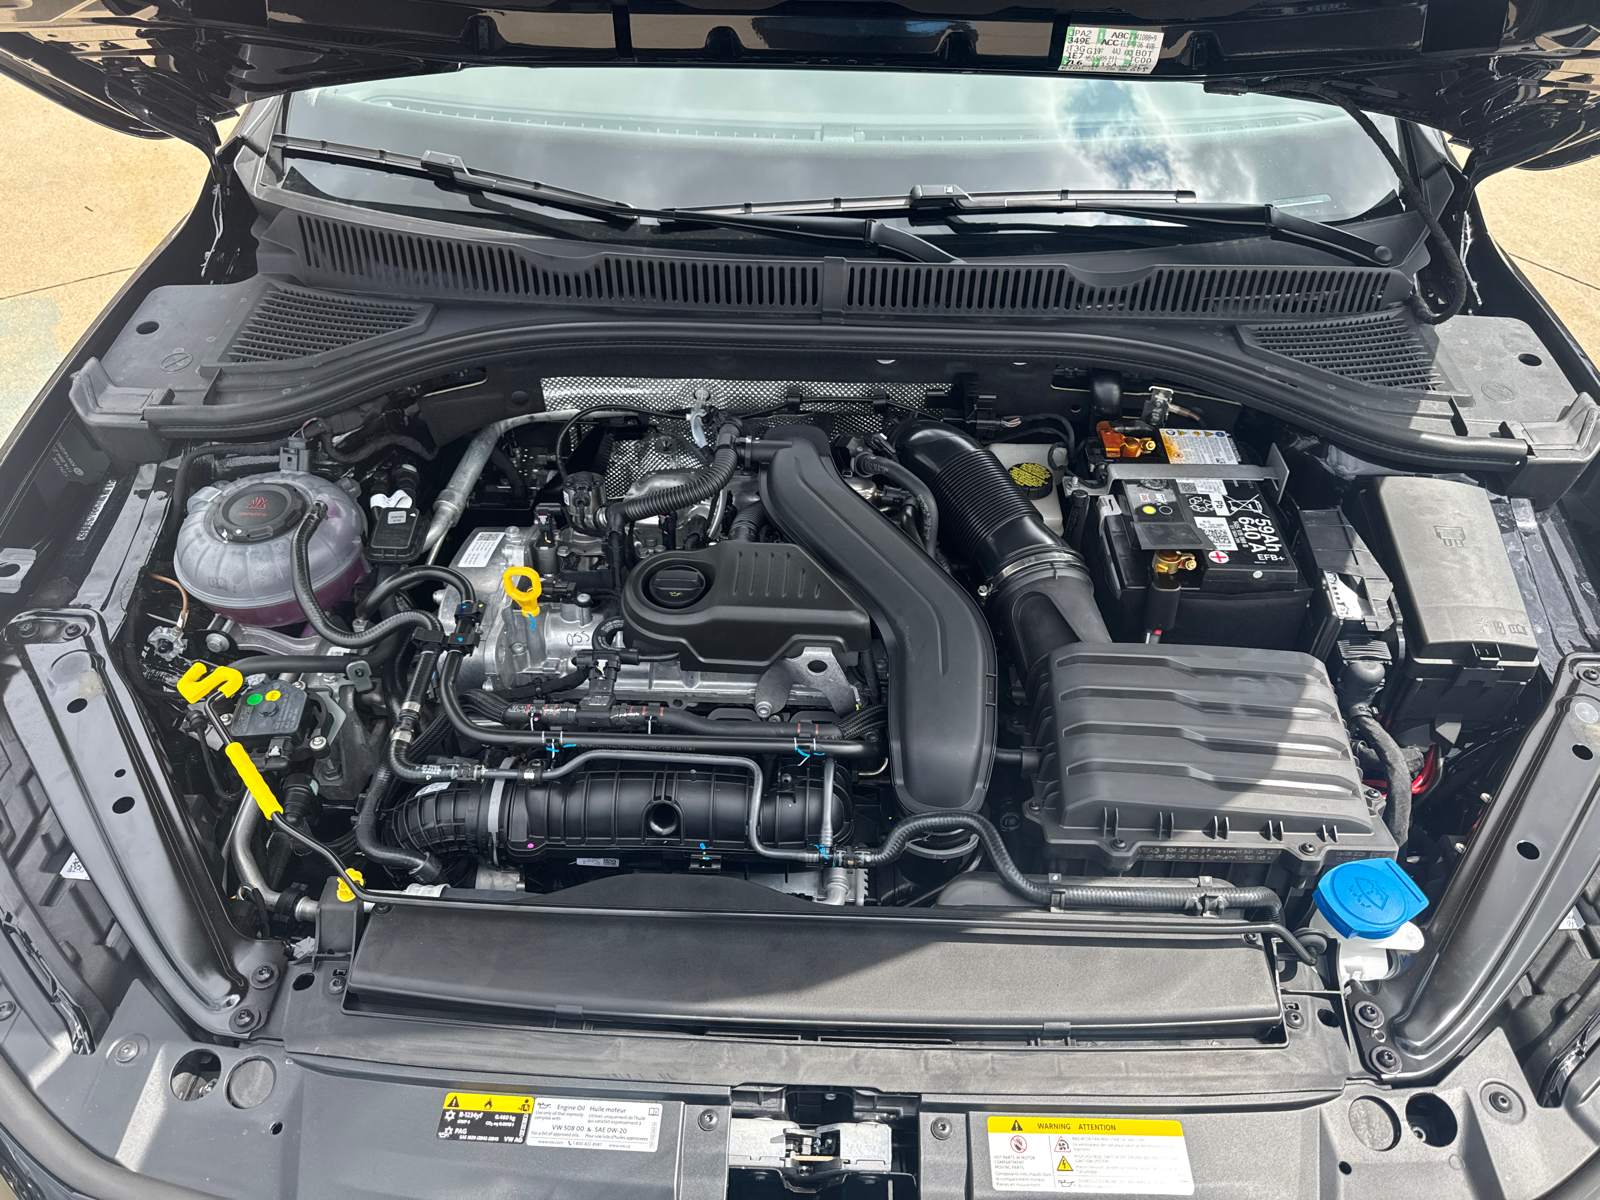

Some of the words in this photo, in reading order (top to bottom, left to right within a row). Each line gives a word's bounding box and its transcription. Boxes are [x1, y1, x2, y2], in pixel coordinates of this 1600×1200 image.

[1214, 501, 1224, 509] Pb
[1238, 517, 1261, 539] 640
[1255, 519, 1282, 551] 59Ah
[1248, 542, 1266, 553] A
[459, 1112, 483, 1120] R-1234yf
